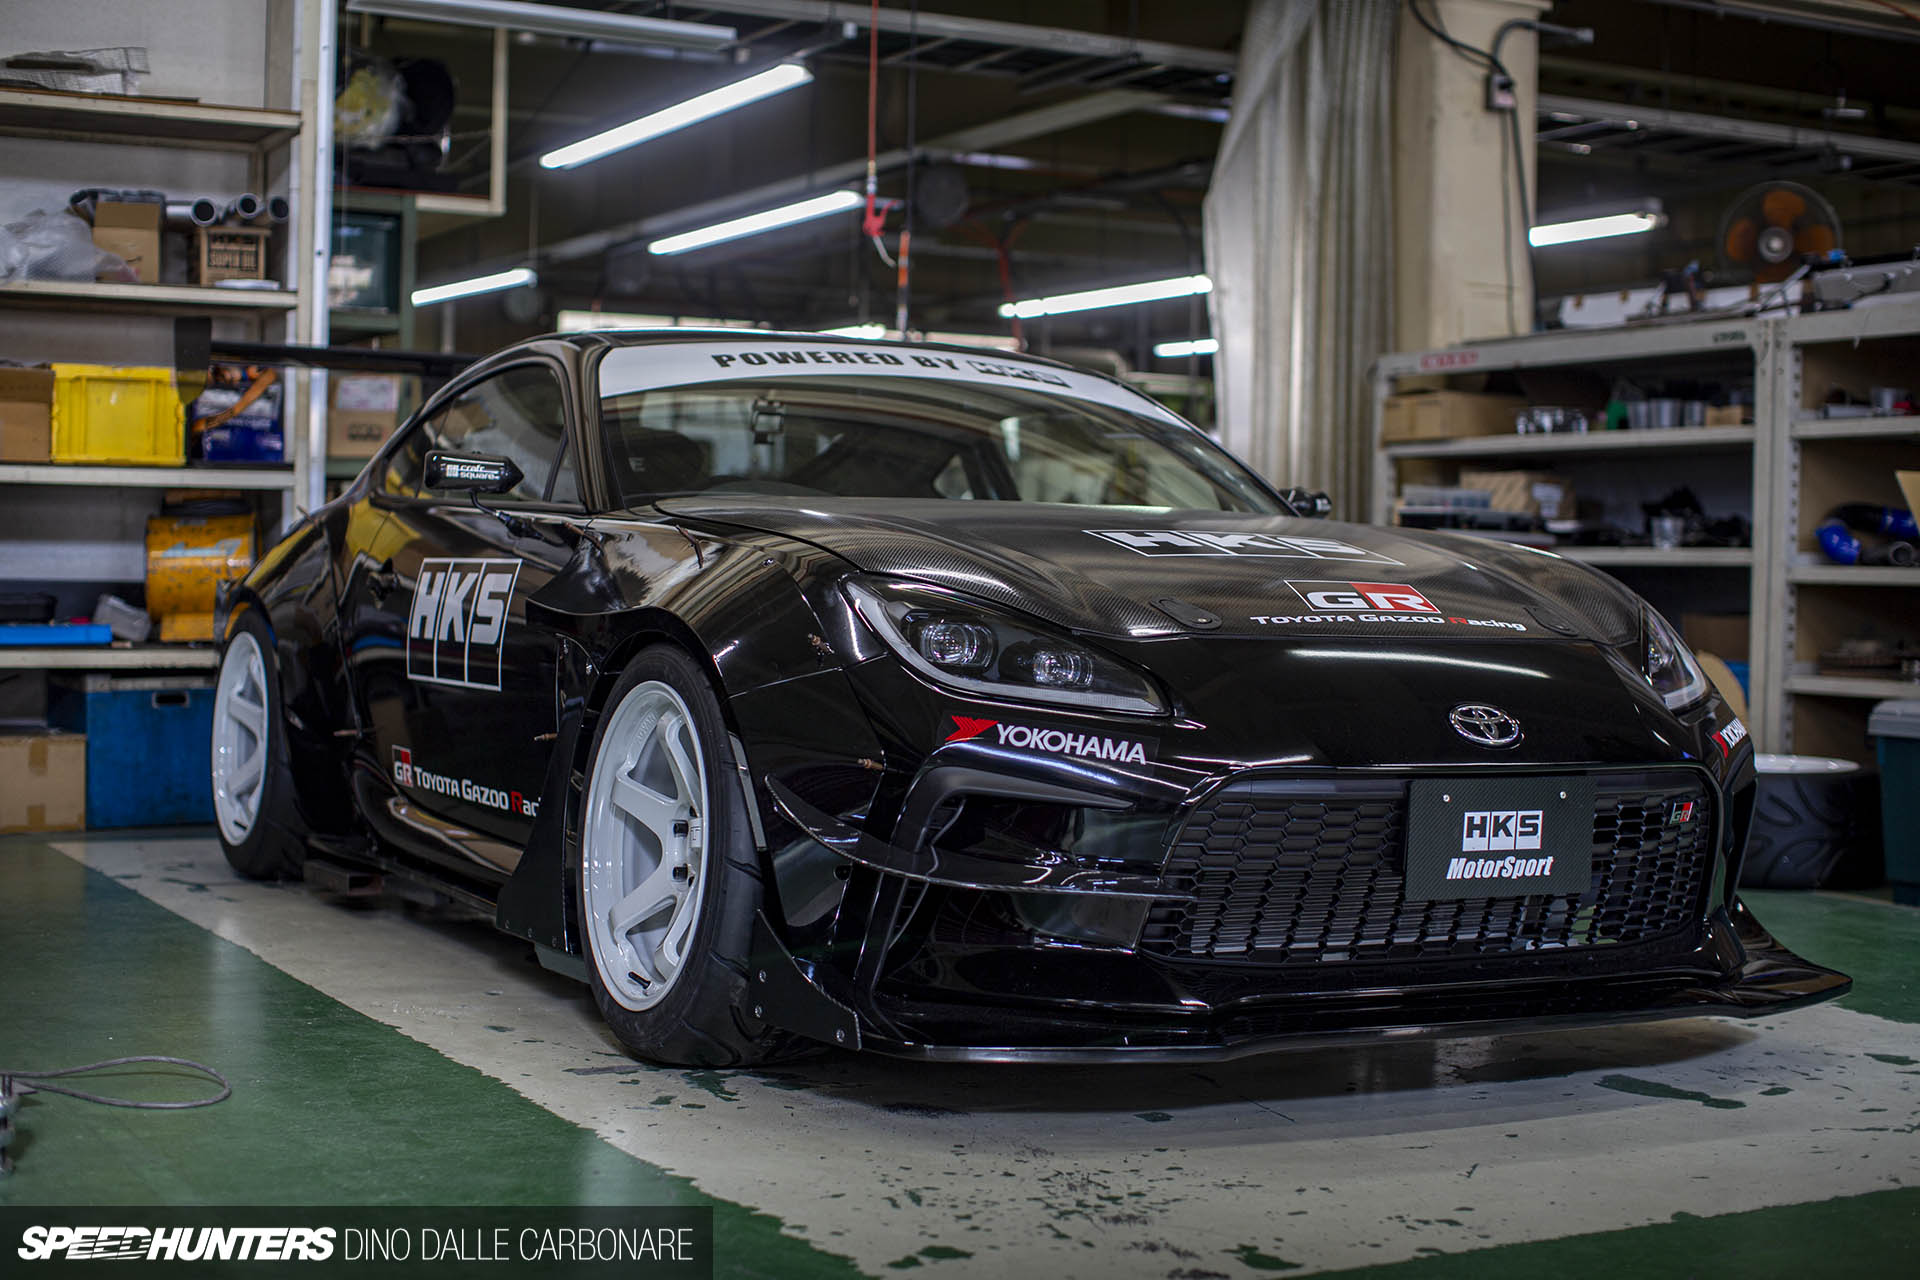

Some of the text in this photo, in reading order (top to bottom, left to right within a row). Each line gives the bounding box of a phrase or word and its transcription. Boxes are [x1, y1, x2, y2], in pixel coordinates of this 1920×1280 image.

[711, 351, 905, 368] POWERED
[911, 355, 960, 371] BY
[1102, 532, 1366, 555] HKS
[410, 571, 513, 645] HKS
[1306, 591, 1436, 611] GR
[1250, 614, 1527, 632] TOYOTA GAZOO Racing
[997, 723, 1147, 765] YOKOHAMA
[394, 761, 542, 817] GR TOYOTA GAZOO Rac
[1465, 814, 1540, 838] HKS
[1446, 856, 1554, 880] MotorSport
